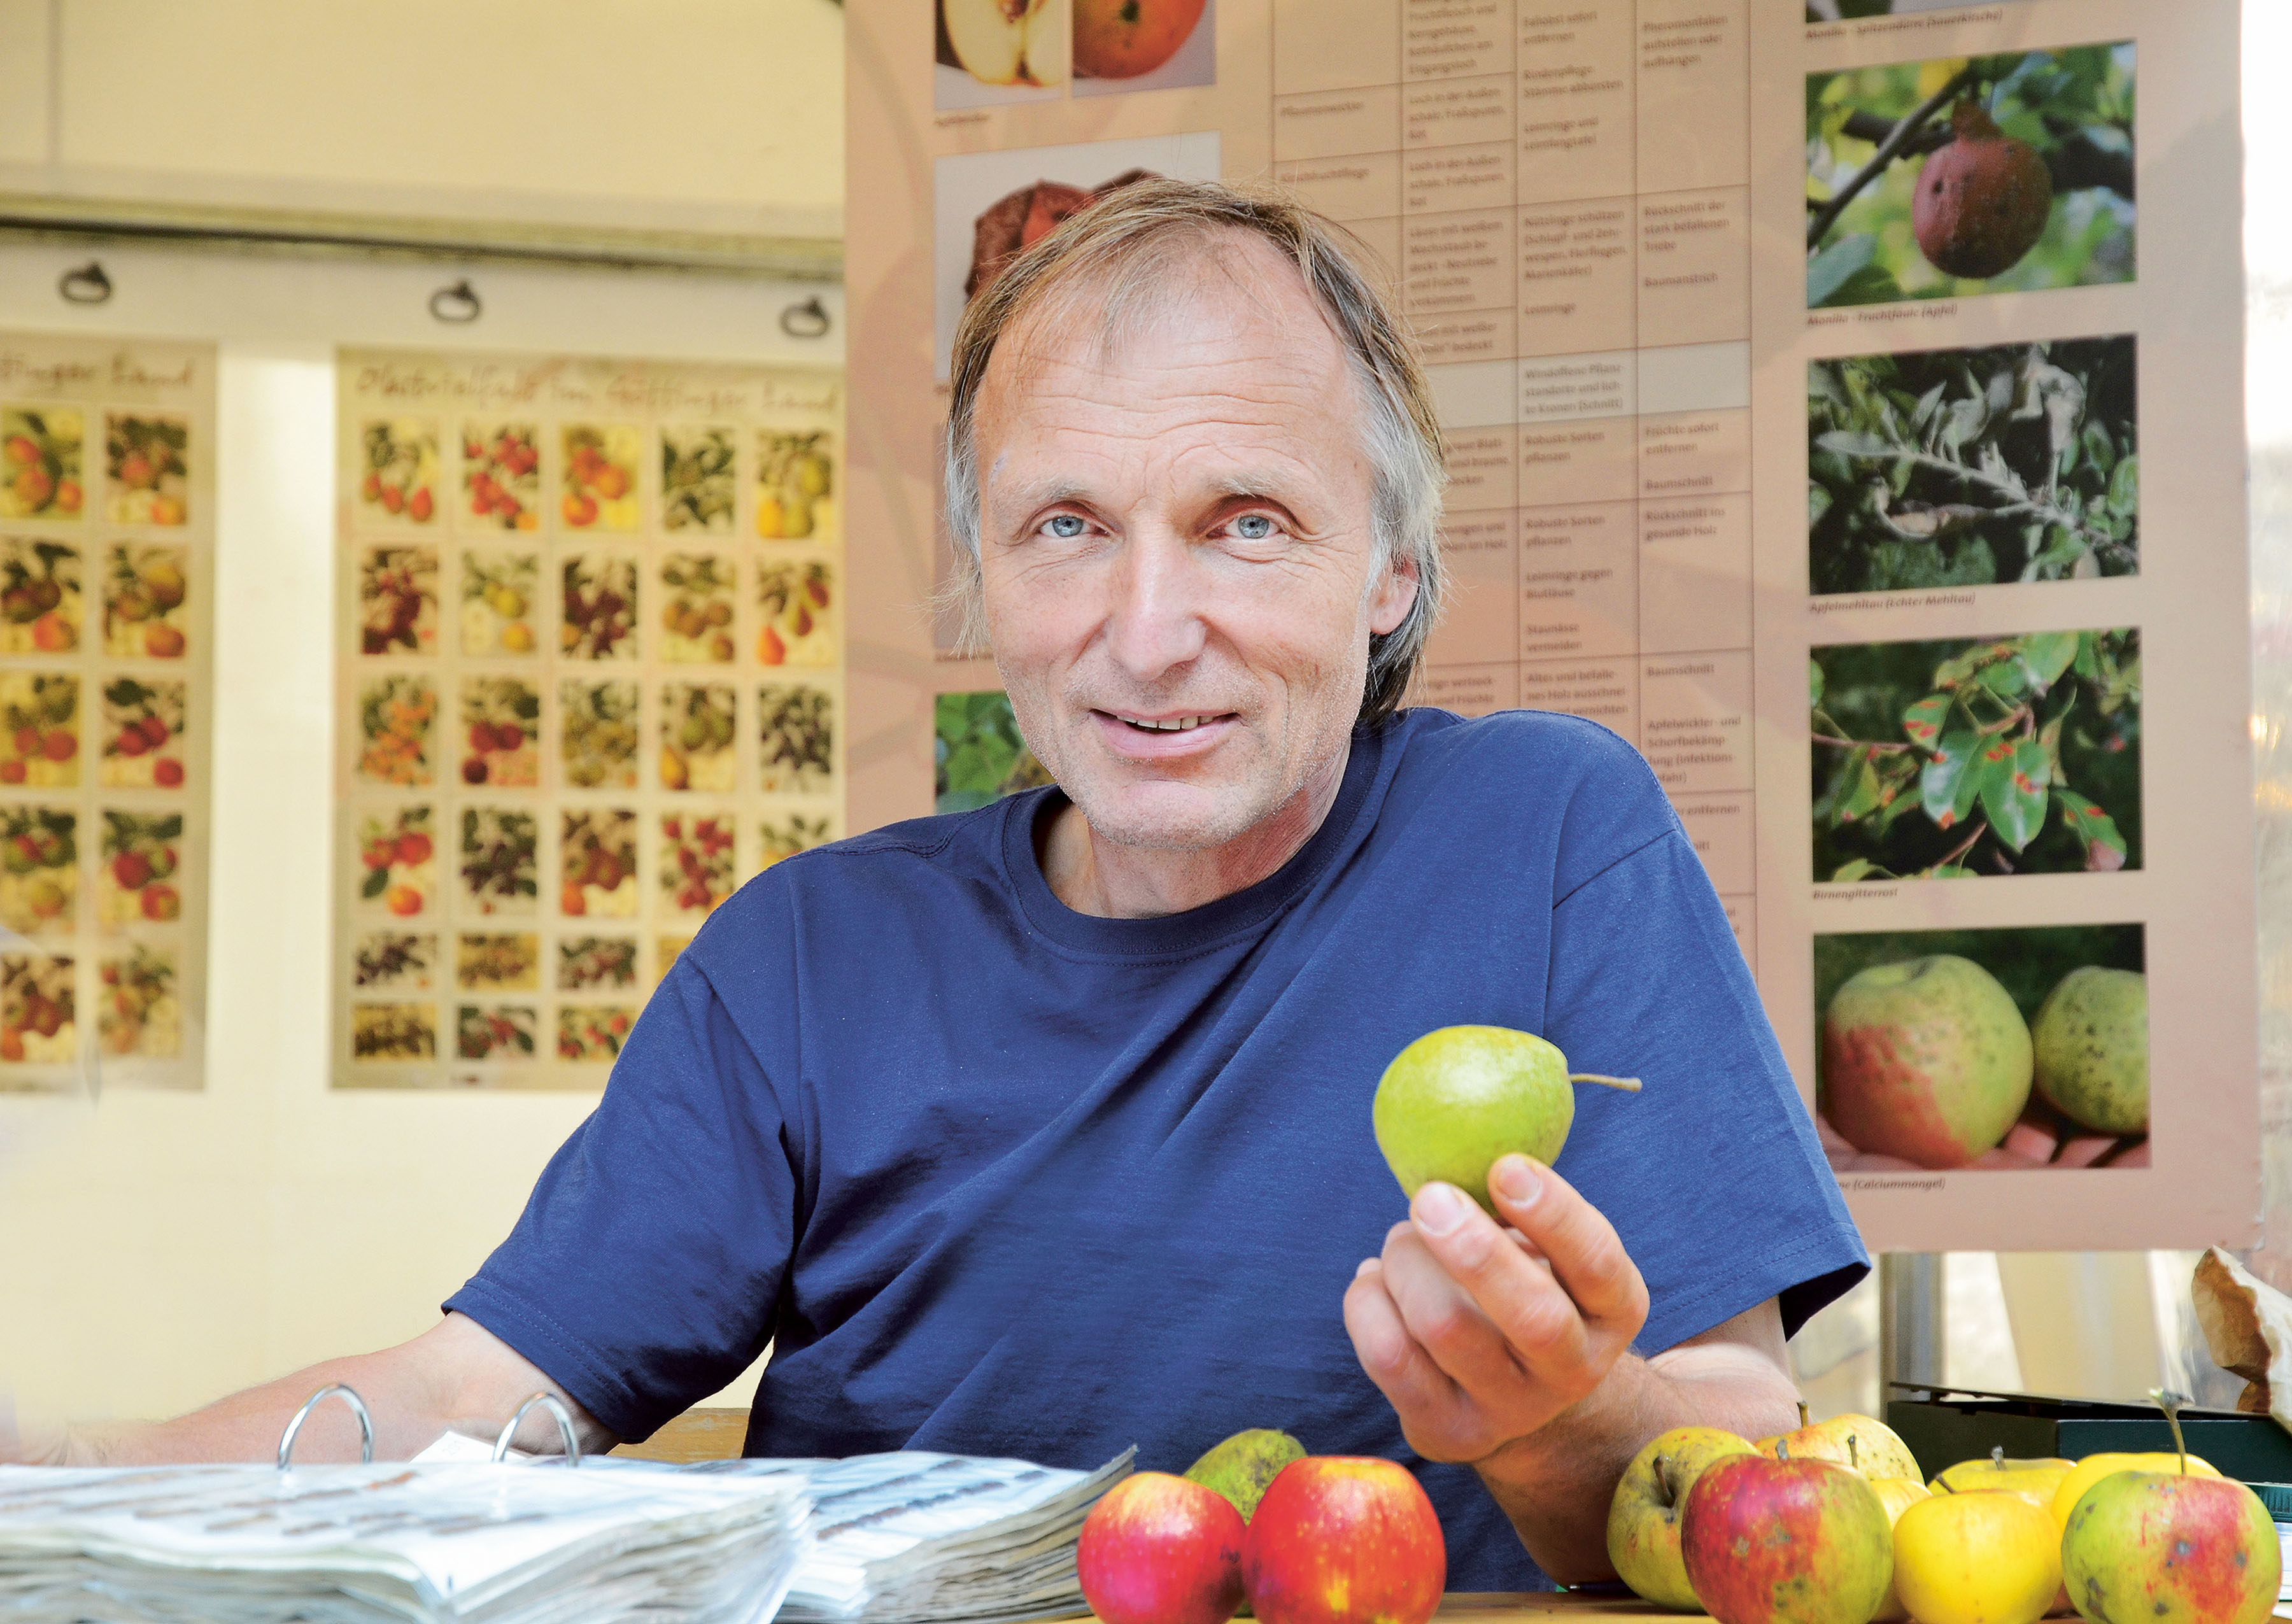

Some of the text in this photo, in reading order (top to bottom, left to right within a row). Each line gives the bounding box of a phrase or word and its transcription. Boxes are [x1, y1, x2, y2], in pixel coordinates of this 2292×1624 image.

[1643, 15, 1728, 32] Pheromonfallen
[1524, 32, 1575, 45] entfernen
[1645, 222, 1670, 235] stark
[1645, 272, 1718, 288] Baumanstrich
[1807, 315, 1848, 327] Monilia
[1921, 302, 1958, 318] (Apfel)
[1538, 402, 1576, 414] Kronen
[1578, 397, 1624, 413] (Schnitt)
[1645, 422, 1720, 437] Früchte sofort
[1525, 431, 1606, 446] Robuste Sorten
[1645, 442, 1699, 455] entfernen
[1525, 451, 1571, 465] pflanzen
[1645, 475, 1713, 490] Baumschnitt
[1645, 507, 1727, 521] Rückschnitt ins
[1525, 515, 1606, 530] Robuste Sorten
[1694, 525, 1718, 536] Holz
[1526, 535, 1572, 549] pflanzen
[1580, 568, 1613, 583] gegen
[1809, 591, 1976, 614] Apfelmehltau (Echter Mehltau)
[1527, 640, 1582, 653] vermeiden
[1555, 670, 1576, 682] und
[1648, 663, 1714, 677] Baumschnitt
[1547, 689, 1571, 701] Holz
[1720, 716, 1741, 727] und
[1687, 804, 1741, 816] entfernen
[1813, 887, 1898, 902] Birnengitterrost
[1853, 1176, 1946, 1192] (Calciummangel)
